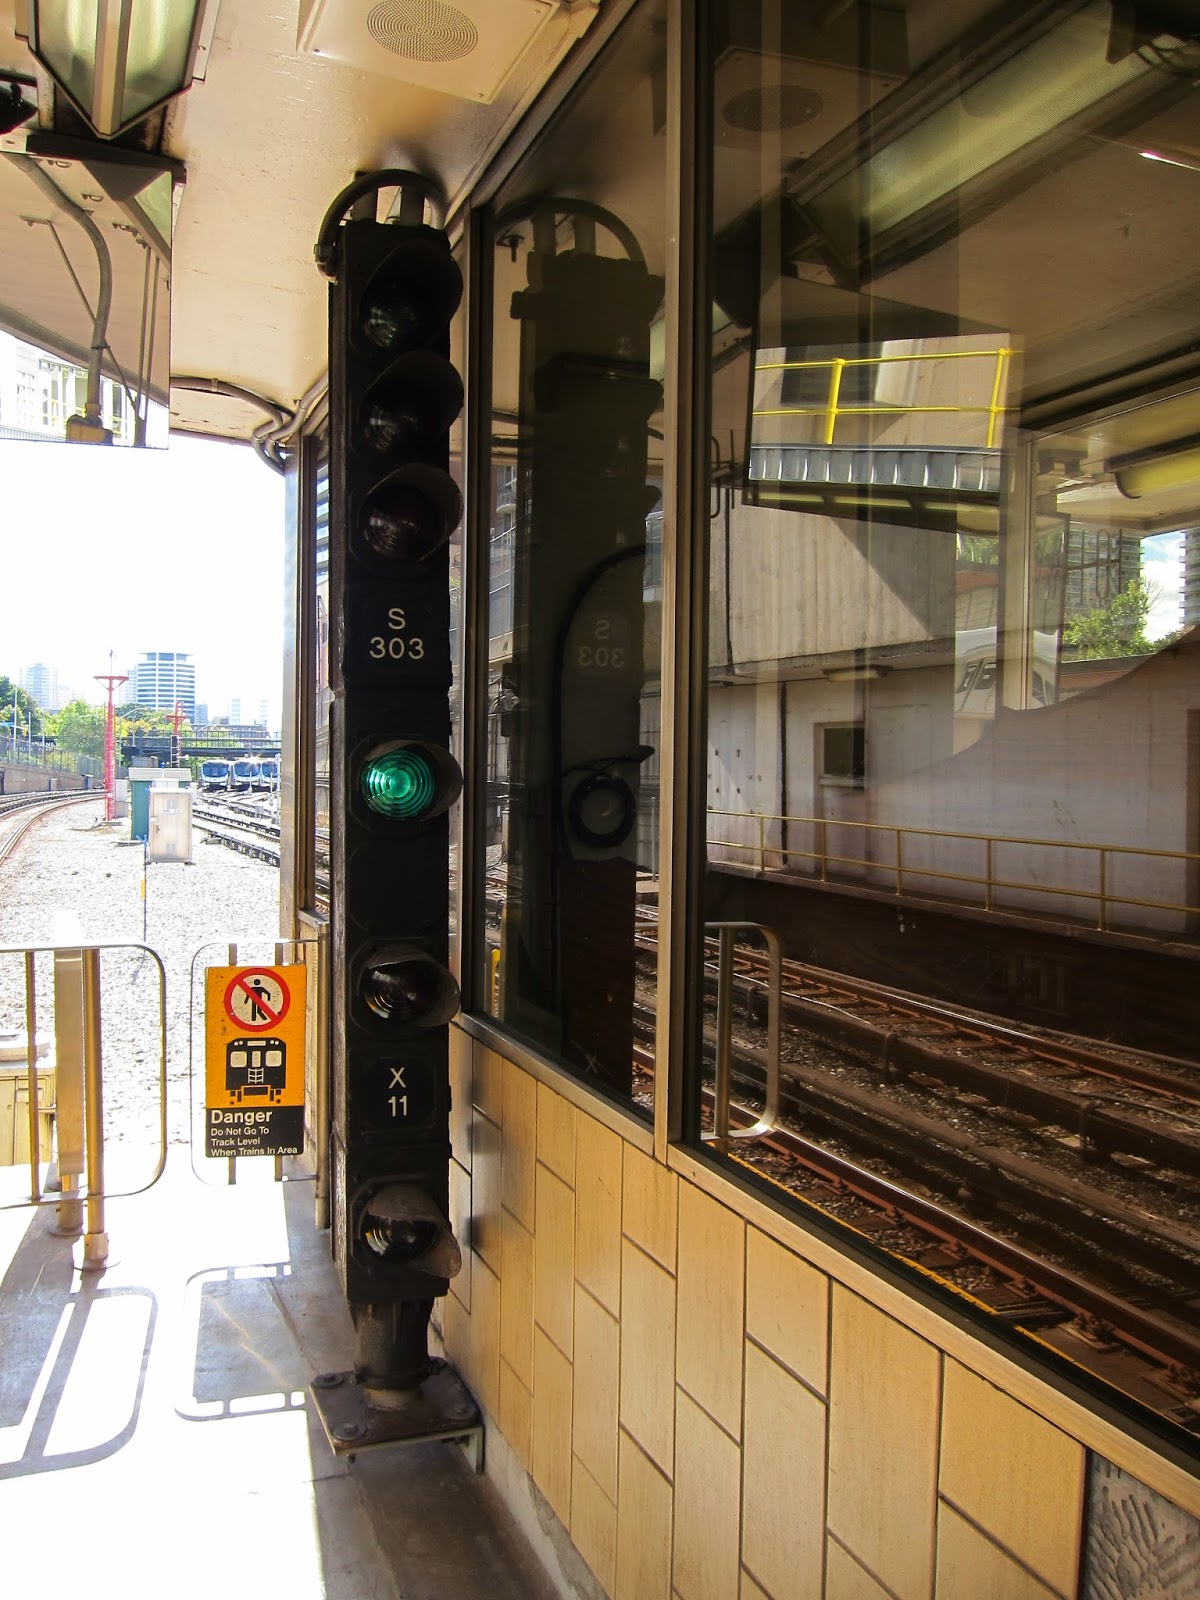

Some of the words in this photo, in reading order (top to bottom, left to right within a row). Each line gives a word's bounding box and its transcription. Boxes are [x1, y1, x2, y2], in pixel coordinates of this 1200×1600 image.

[388, 607, 406, 630] S
[369, 636, 425, 660] 303
[388, 1067, 406, 1089] X
[388, 1095, 408, 1117] 11
[211, 1109, 273, 1126] Danger
[211, 1128, 224, 1136] Do
[226, 1127, 242, 1135] Not
[244, 1126, 257, 1135] Go
[259, 1126, 270, 1134] To
[211, 1138, 235, 1146] Track
[237, 1137, 260, 1145] Level
[211, 1148, 236, 1157] When
[239, 1147, 265, 1155] Trains
[267, 1146, 275, 1154] In
[277, 1146, 298, 1154] Area
